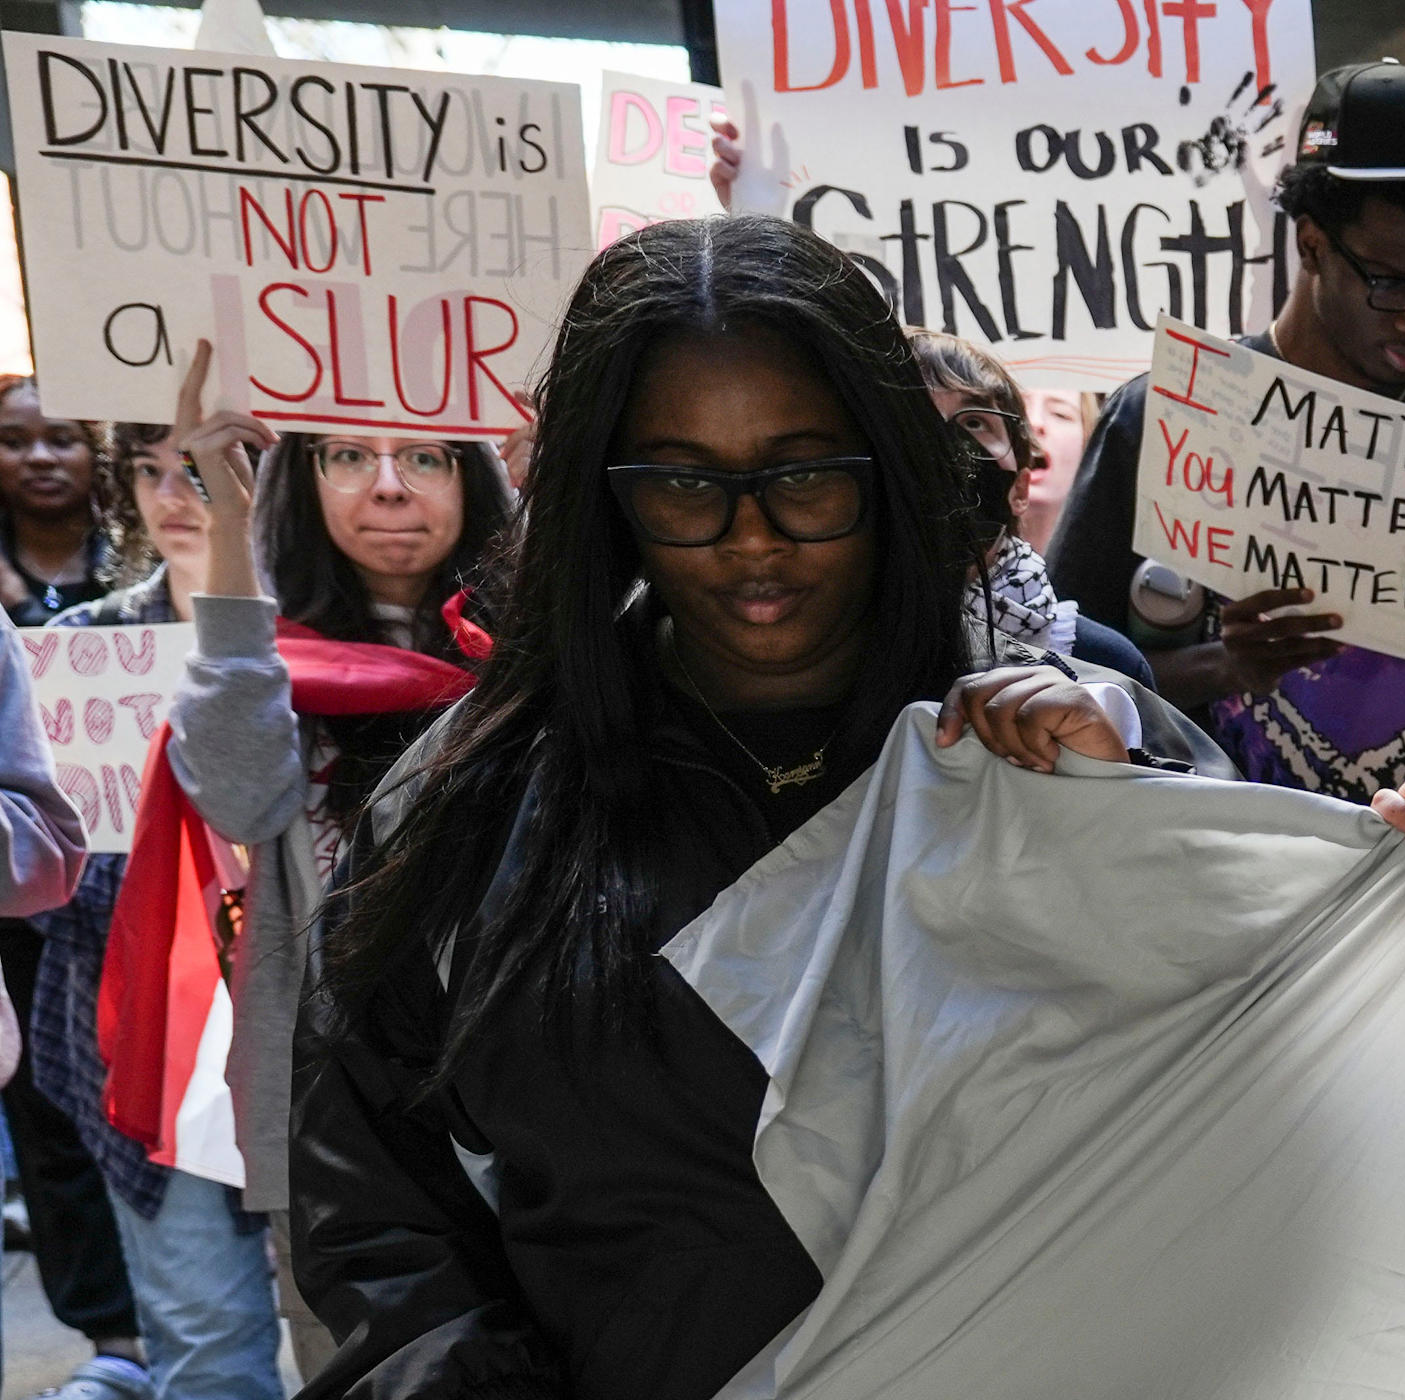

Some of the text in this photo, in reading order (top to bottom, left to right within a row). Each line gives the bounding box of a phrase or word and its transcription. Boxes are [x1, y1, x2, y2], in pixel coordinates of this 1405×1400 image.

[37, 50, 548, 183] DIVERSITY is
[608, 90, 727, 180] DE
[903, 122, 1175, 179] IS OUR
[239, 186, 386, 277] NOT
[103, 282, 536, 424] a SLUR
[1152, 328, 1231, 416] I
[1153, 499, 1235, 568] WE
[22, 629, 156, 680] YOU
